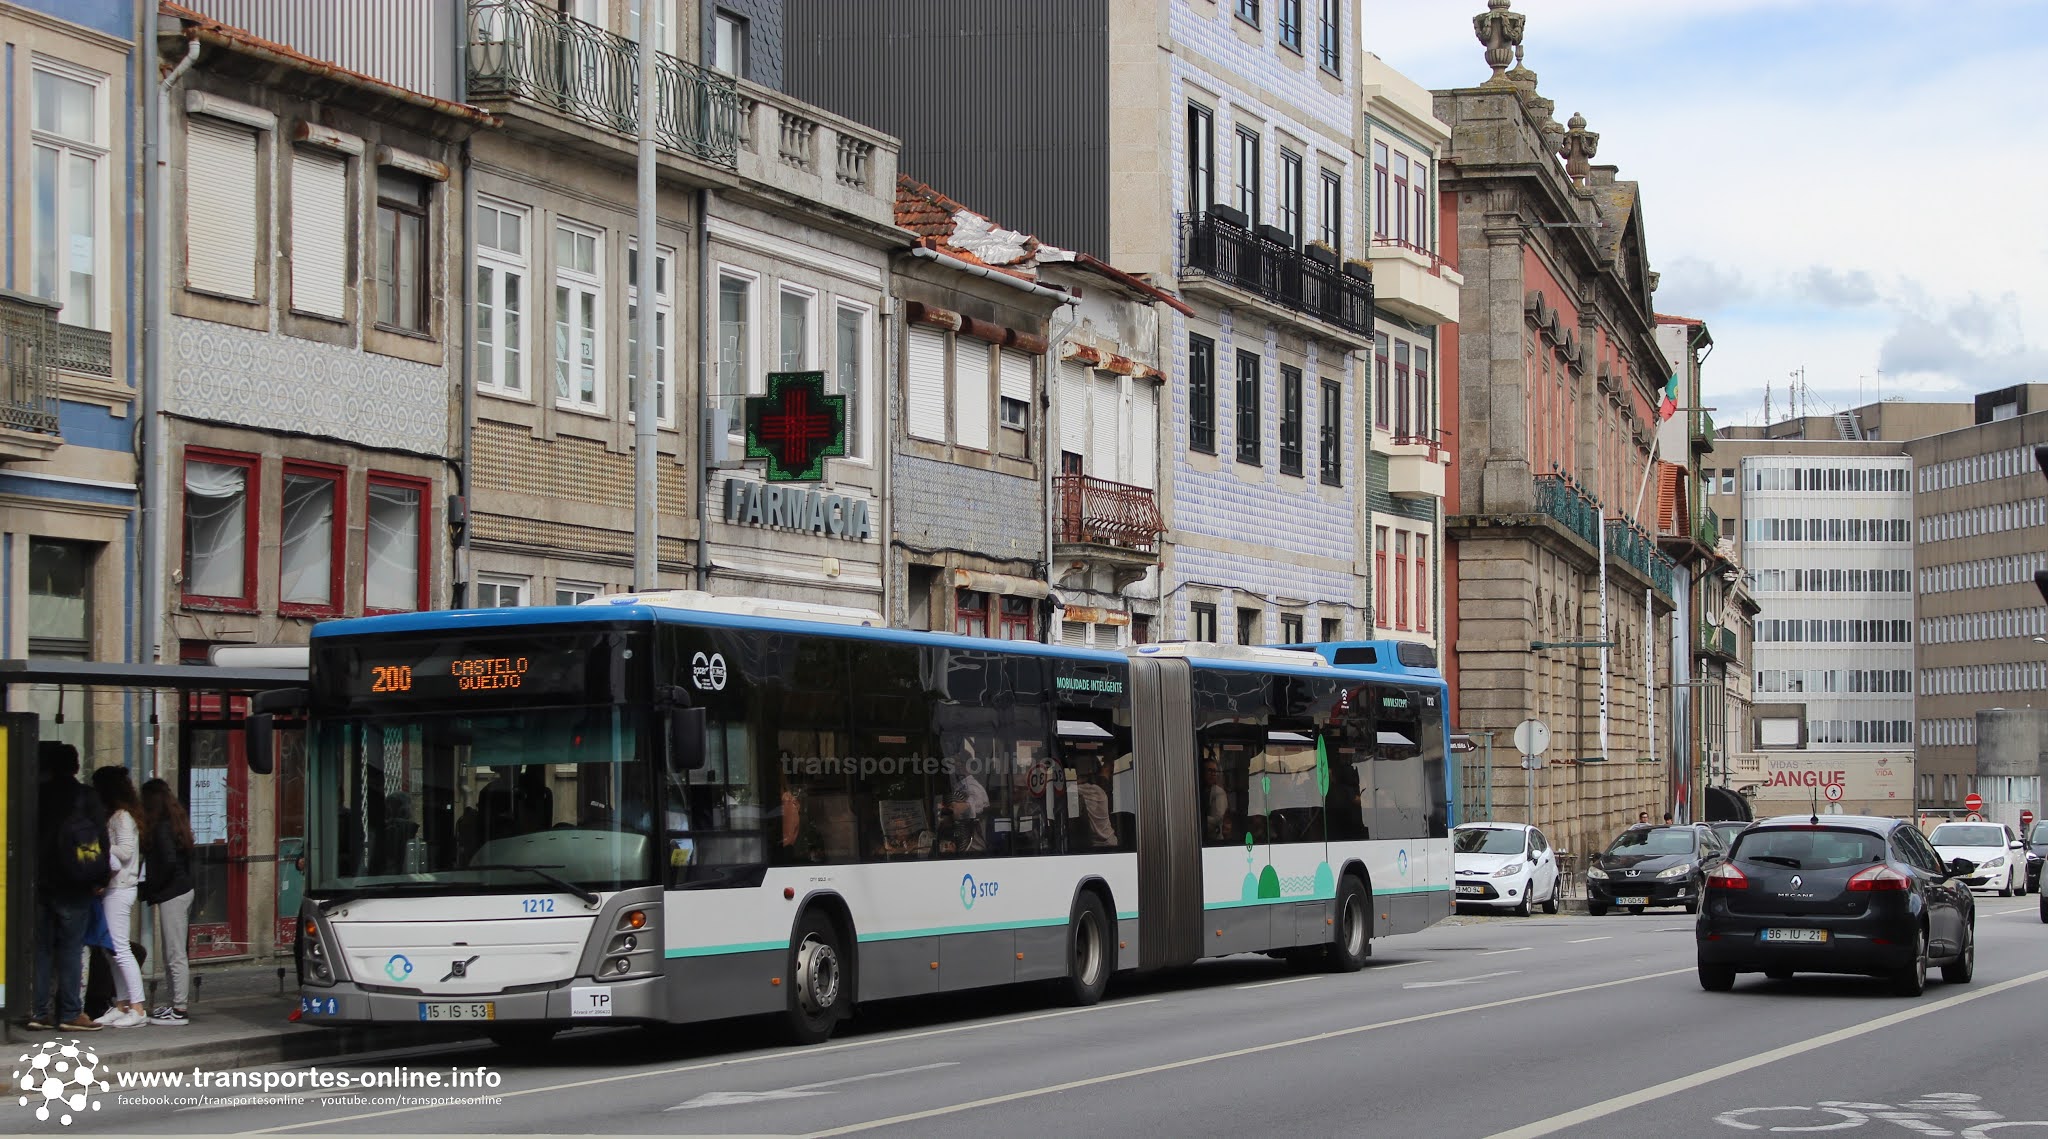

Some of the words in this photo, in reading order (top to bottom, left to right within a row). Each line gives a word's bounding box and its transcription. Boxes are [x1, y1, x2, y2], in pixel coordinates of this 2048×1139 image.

[724, 478, 872, 539] FARMÁCIA
[451, 657, 528, 676] CASTELO
[371, 665, 412, 692] 200
[458, 674, 521, 690] QUEIJO
[1056, 676, 1090, 691] MOBILIDADE
[1090, 679, 1123, 693] INTELIGENTE
[1762, 770, 1846, 787] SANGUE
[979, 881, 999, 897] STCP
[522, 898, 554, 913] 1212
[590, 994, 610, 1007] TP
